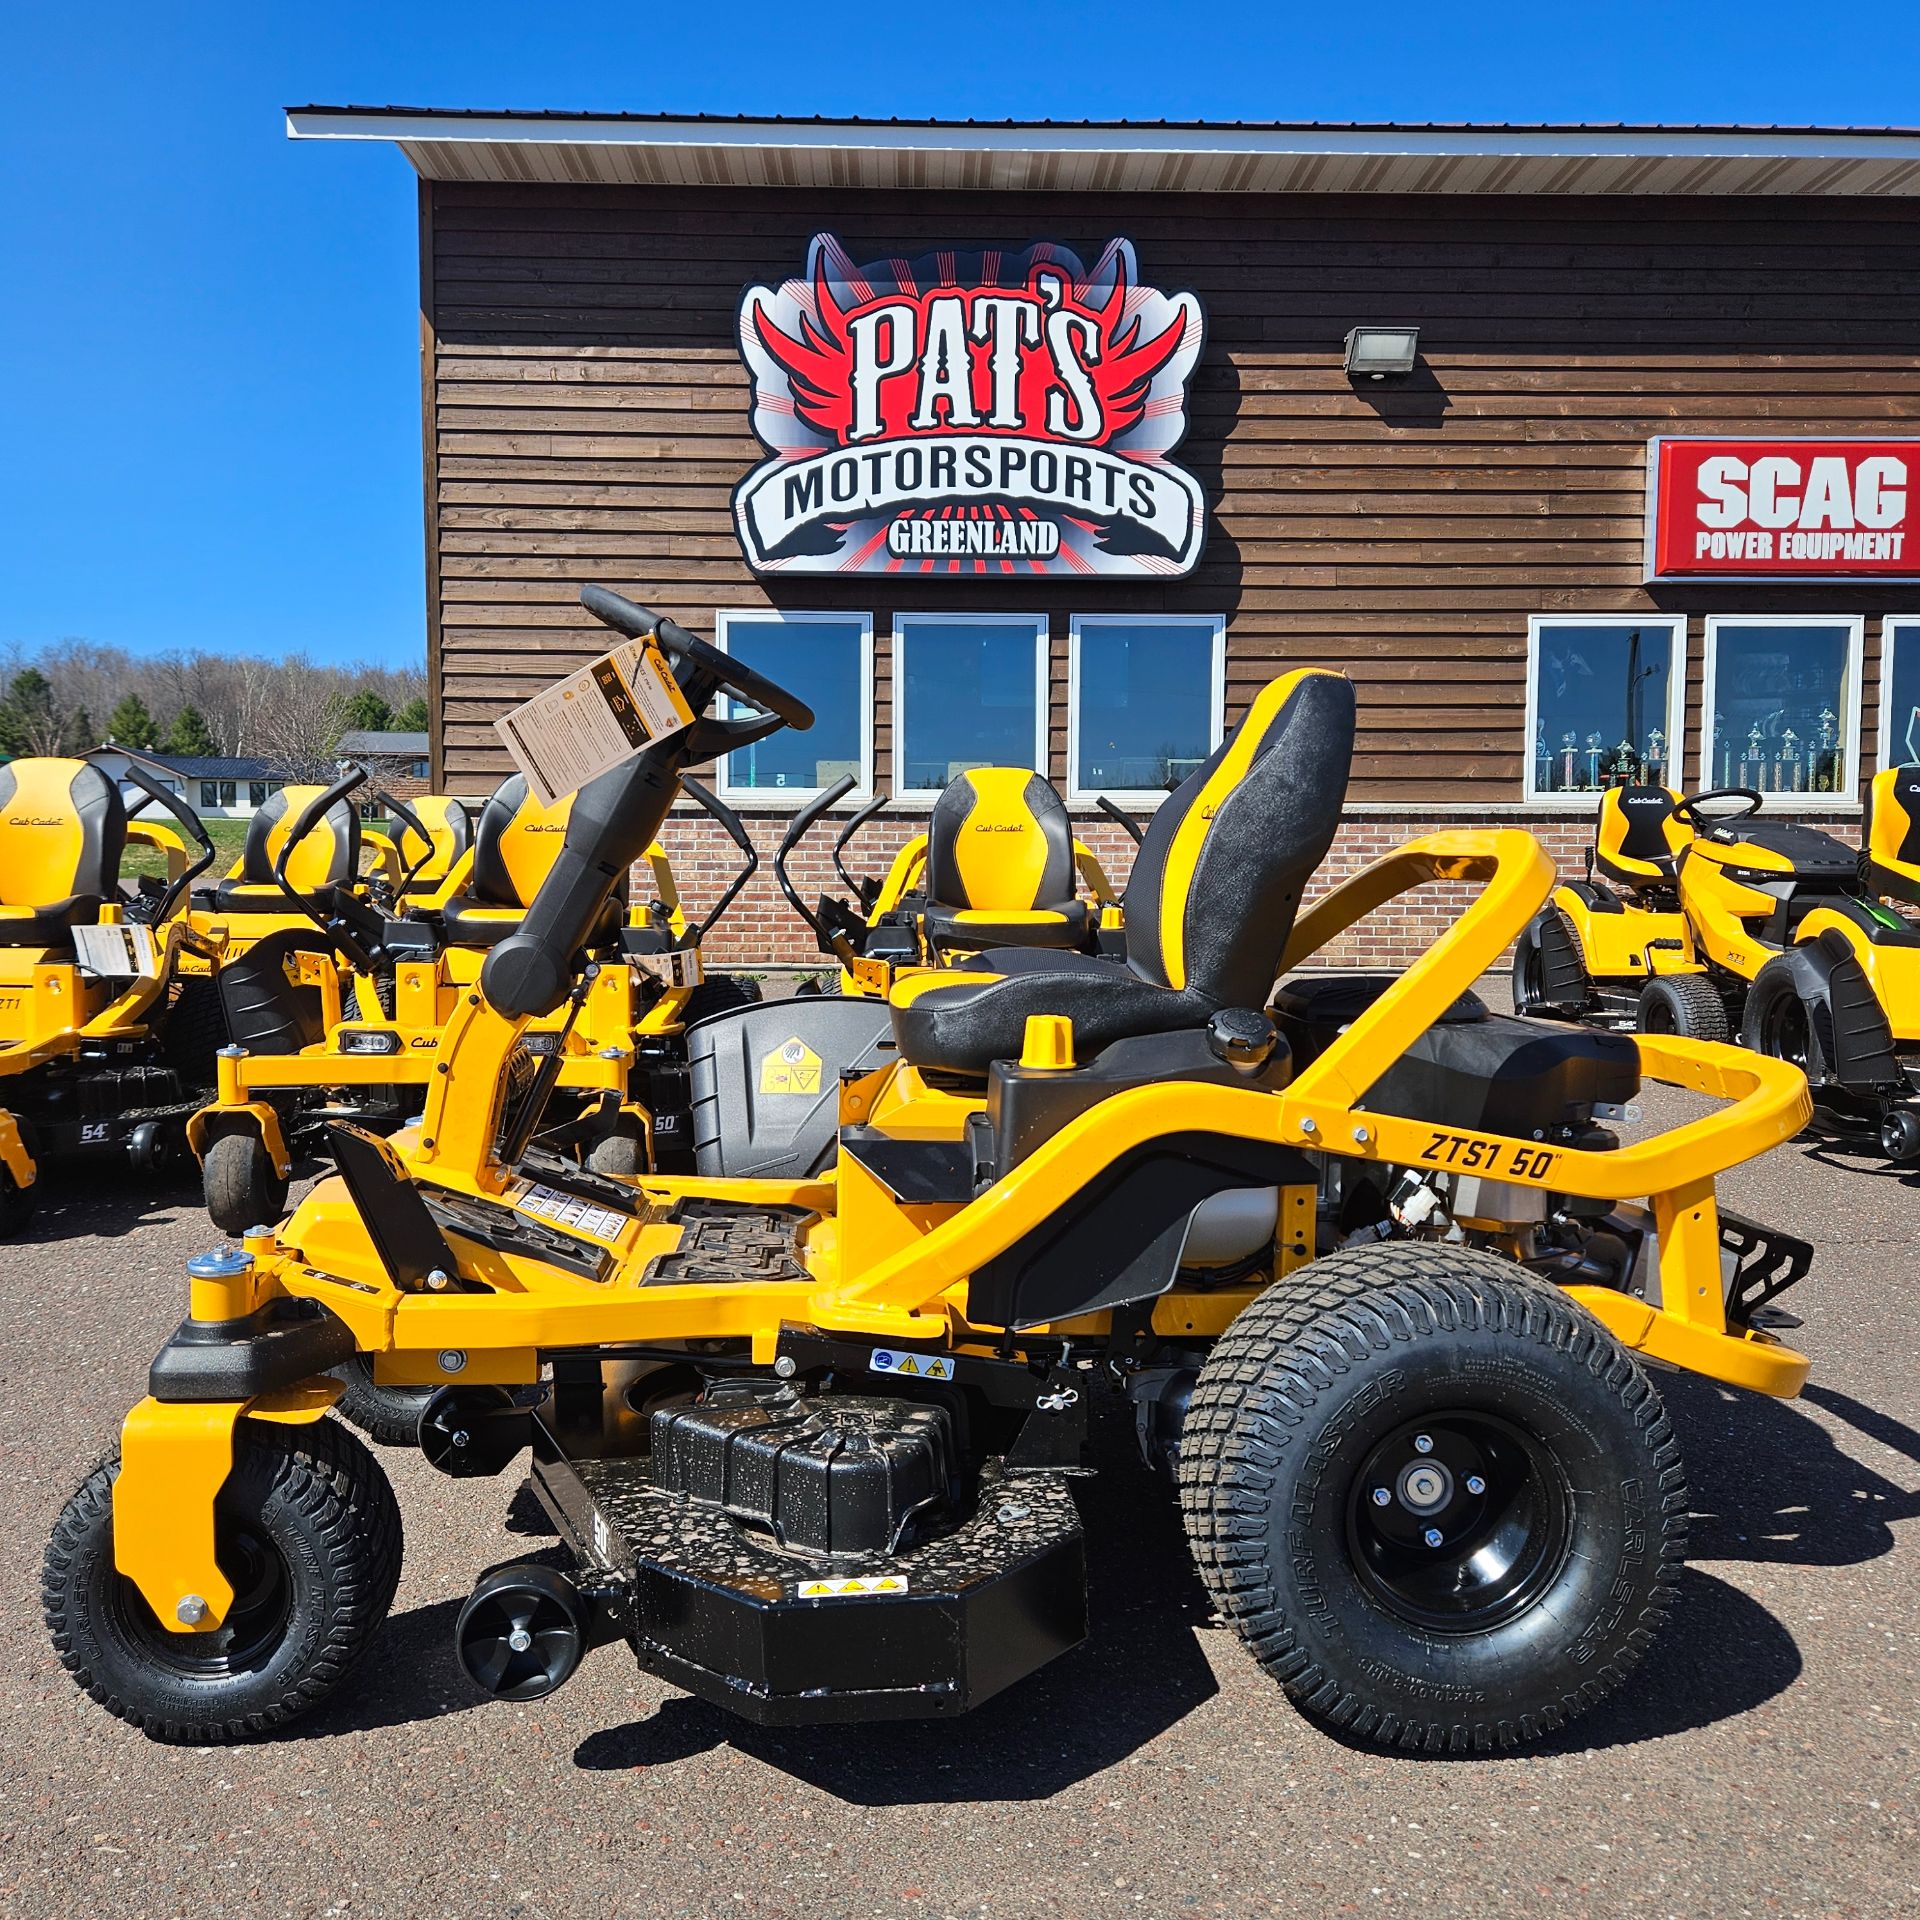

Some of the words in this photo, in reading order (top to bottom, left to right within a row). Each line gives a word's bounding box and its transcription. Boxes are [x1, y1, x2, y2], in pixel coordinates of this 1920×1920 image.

[850, 276, 1101, 440] PAT'S
[783, 445, 1158, 521] MOTORSPORTS
[1696, 456, 1908, 529] SCAG
[889, 518, 1060, 556] GREENLAND
[1696, 532, 1773, 559] POWER
[1779, 532, 1905, 560] EQUIPMENT
[9, 817, 29, 826] Cub
[31, 817, 64, 826] Cadet
[524, 824, 543, 832] Cub
[975, 824, 993, 832] Cub
[994, 824, 1024, 832] Cadet
[411, 1036, 438, 1048] Cub
[1421, 1133, 1502, 1170] ZTS1
[1293, 1368, 1406, 1526] MASTER
[1566, 1478, 1645, 1667] CARLSTAR
[74, 1548, 102, 1661] CARLSTAR
